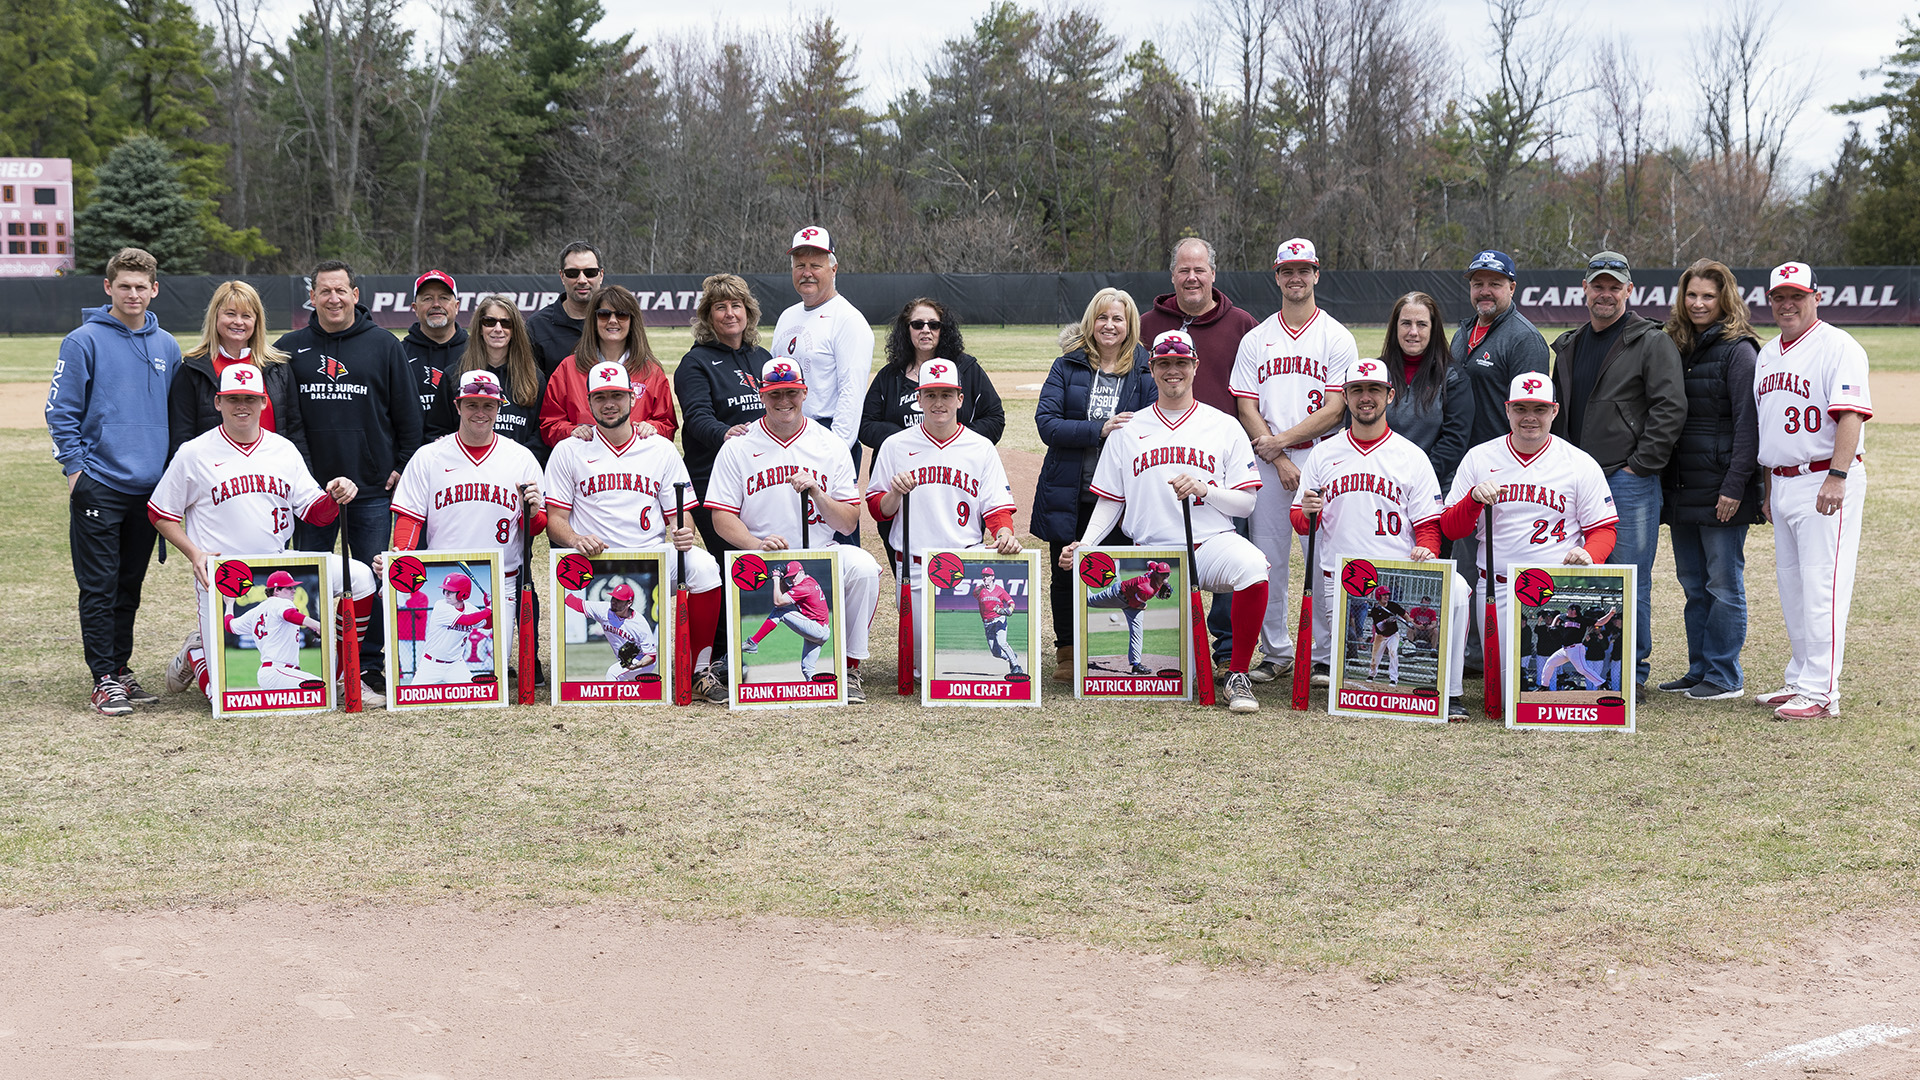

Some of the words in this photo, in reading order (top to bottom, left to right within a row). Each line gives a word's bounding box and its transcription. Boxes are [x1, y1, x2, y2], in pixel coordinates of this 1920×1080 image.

[0, 161, 43, 178] IELD
[1257, 355, 1328, 385] CARDINALS
[1306, 389, 1323, 415] 3
[1784, 405, 1822, 434] 30
[1133, 446, 1216, 477] CARDINALS
[434, 482, 518, 513] CARDINALS
[579, 472, 660, 498] CARDINALS
[1325, 473, 1401, 506] CARDINALS
[271, 507, 290, 535] 15
[639, 506, 652, 531] 6
[956, 501, 971, 527] 9
[1374, 509, 1402, 536] 10
[495, 517, 511, 544] 8
[1530, 518, 1567, 545] 24
[398, 687, 442, 702] JORDAN
[444, 685, 495, 700] GODFREY
[580, 684, 614, 698] MATT
[617, 684, 640, 697] FOX
[740, 685, 775, 700] FRANK
[776, 683, 836, 698] FINKBEINER
[948, 683, 971, 697] JON
[974, 683, 1013, 697] CRAFT
[1085, 679, 1133, 692] PATRICK
[1135, 679, 1181, 692] BRYANT
[226, 694, 263, 709] RYAN
[265, 690, 322, 707] WHALEN
[1340, 692, 1378, 708] ROCCO
[1380, 695, 1437, 713] CIPRIANO
[1537, 706, 1553, 720] PJ
[1555, 706, 1599, 721] WEEKS
